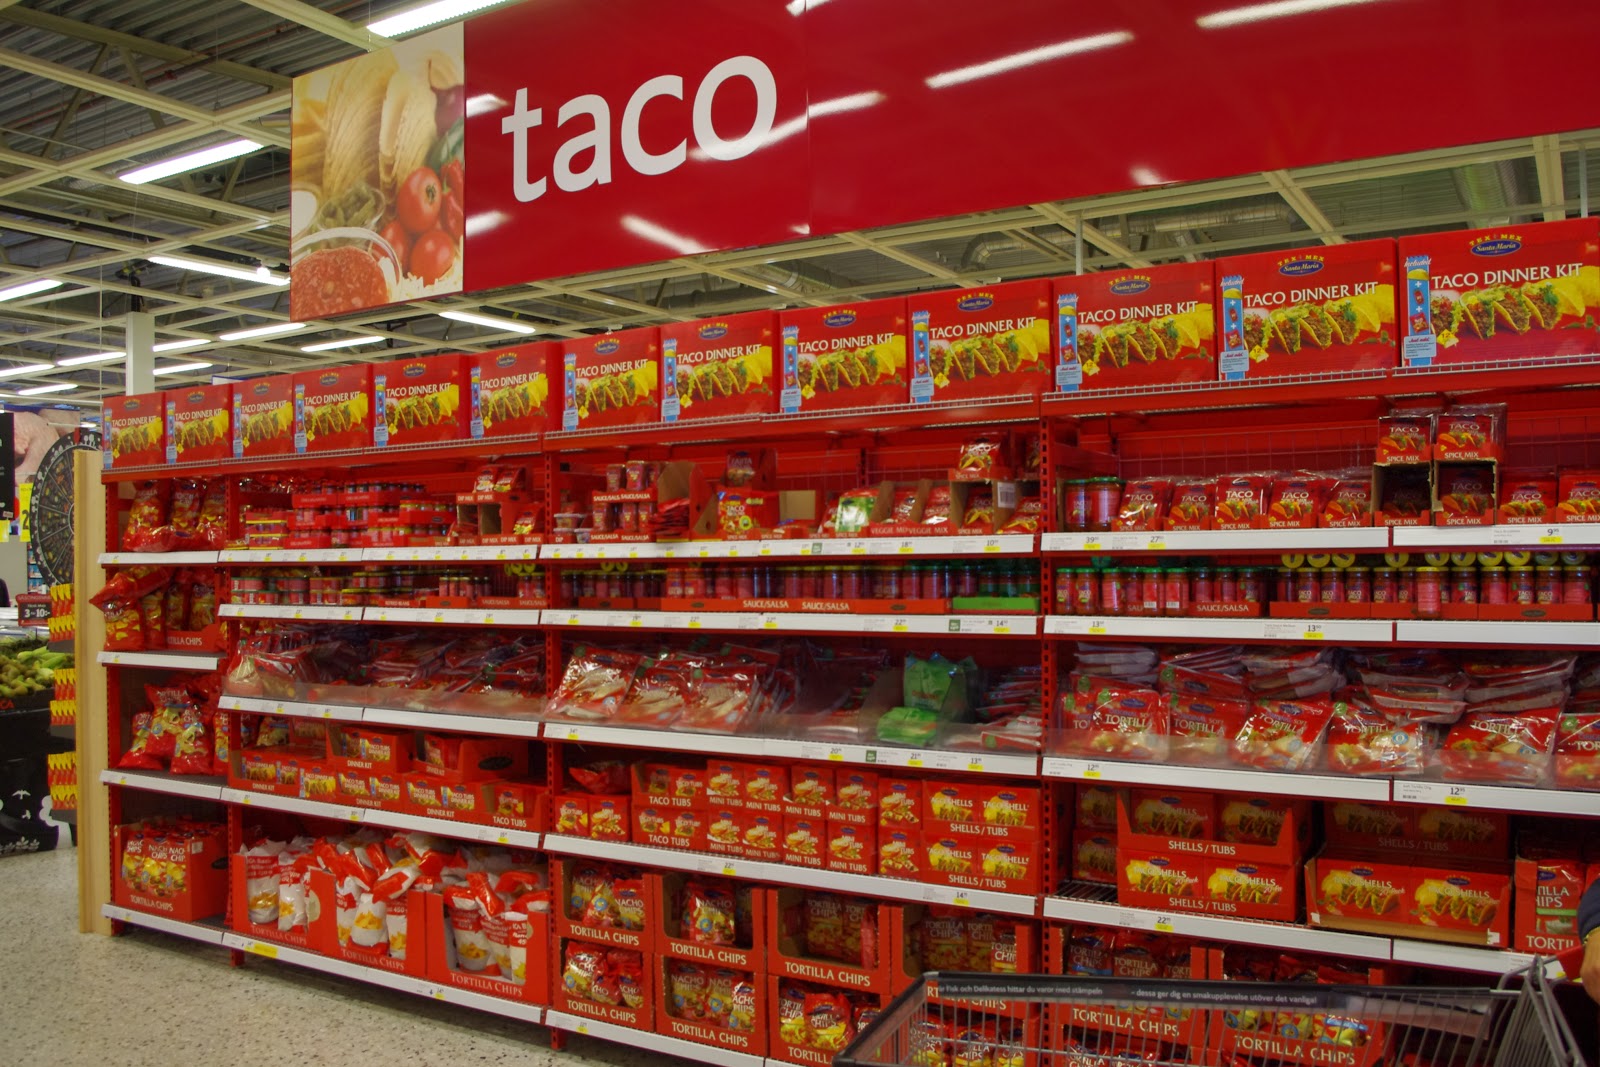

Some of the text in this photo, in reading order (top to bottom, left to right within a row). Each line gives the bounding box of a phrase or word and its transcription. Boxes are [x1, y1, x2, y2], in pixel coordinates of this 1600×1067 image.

[502, 55, 777, 203] taco
[1469, 235, 1490, 246] TEX
[1283, 261, 1320, 272] Santa Maria
[1432, 263, 1583, 289] TACO DINNER KIT
[1244, 282, 1378, 308] TACO DINNER KIT
[1078, 301, 1198, 323] TACO DINNER KIT
[930, 317, 1036, 339] TACO DINNER KIT
[799, 333, 894, 352] TACO DINNER KIT
[677, 344, 762, 364] TACO DINNER KIT
[576, 366, 598, 377] TACO
[601, 362, 632, 374] DINNER
[802, 602, 850, 610] SAUCE/SALSA
[1174, 719, 1225, 735] TORTILLA
[649, 796, 691, 807] TACO TUBS
[709, 796, 743, 806] MINI TUBS
[746, 802, 780, 812] MINI TUBS
[785, 806, 821, 817] MINI TUBS
[829, 812, 865, 823] MINI TUBS
[493, 816, 526, 827] TACO TUBS
[950, 824, 980, 833] SHELLS
[987, 827, 1008, 836] TUBS
[648, 835, 690, 847] TACO TUBS
[1169, 840, 1203, 852] SHELLS
[1211, 844, 1235, 855] TUBS
[786, 854, 821, 866] MINI TUBS
[830, 861, 867, 872] MINI TUBS
[949, 874, 978, 885] SHELLS
[985, 878, 1006, 888] TUBS
[130, 895, 155, 907] TORTILLA
[1169, 898, 1204, 909] SHELLS
[1212, 901, 1236, 912] TUBS
[1536, 897, 1562, 907] HIPS
[250, 926, 307, 945] TORTILLA CHIPS
[570, 925, 639, 946] TORTILLA CHIPS
[341, 949, 404, 970] TORTILLA CHIPS
[670, 942, 747, 965] TORTILLA CHIPS
[785, 962, 870, 987] TORTILLA CHIPS
[450, 973, 522, 996] TORTILLA CHIPS
[567, 1000, 636, 1023] TORTILLA CHIPS
[1072, 1008, 1179, 1036] TORTILLA CHIPS
[672, 1022, 748, 1047] TORTILLA CHIPS
[788, 1046, 832, 1065] TORTILL
[1234, 1035, 1355, 1065] TORTILLA CHIPS
